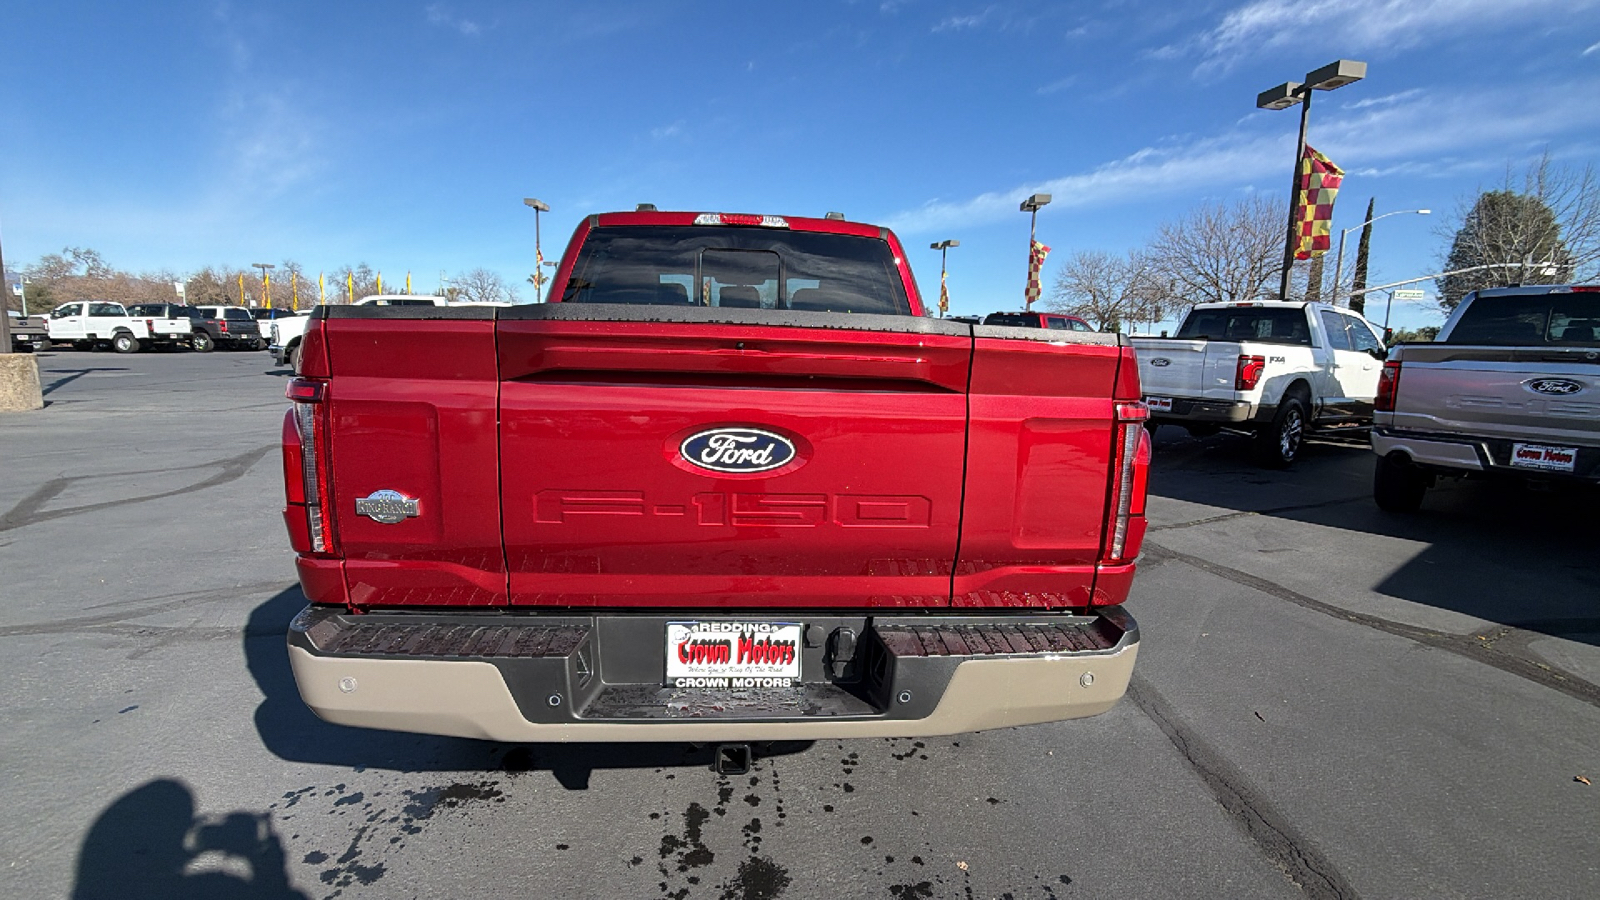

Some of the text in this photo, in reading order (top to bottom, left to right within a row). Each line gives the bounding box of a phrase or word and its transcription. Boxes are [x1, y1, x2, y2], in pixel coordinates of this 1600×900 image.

[1269, 356, 1286, 364] FX4
[1538, 381, 1573, 393] Ford
[701, 433, 775, 466] Ford
[358, 500, 415, 514] KING RANCH
[532, 489, 932, 528] F-150
[699, 623, 771, 633] REDDING
[678, 633, 795, 665] Crown Motors
[675, 677, 792, 688] CROWN MOTORS
